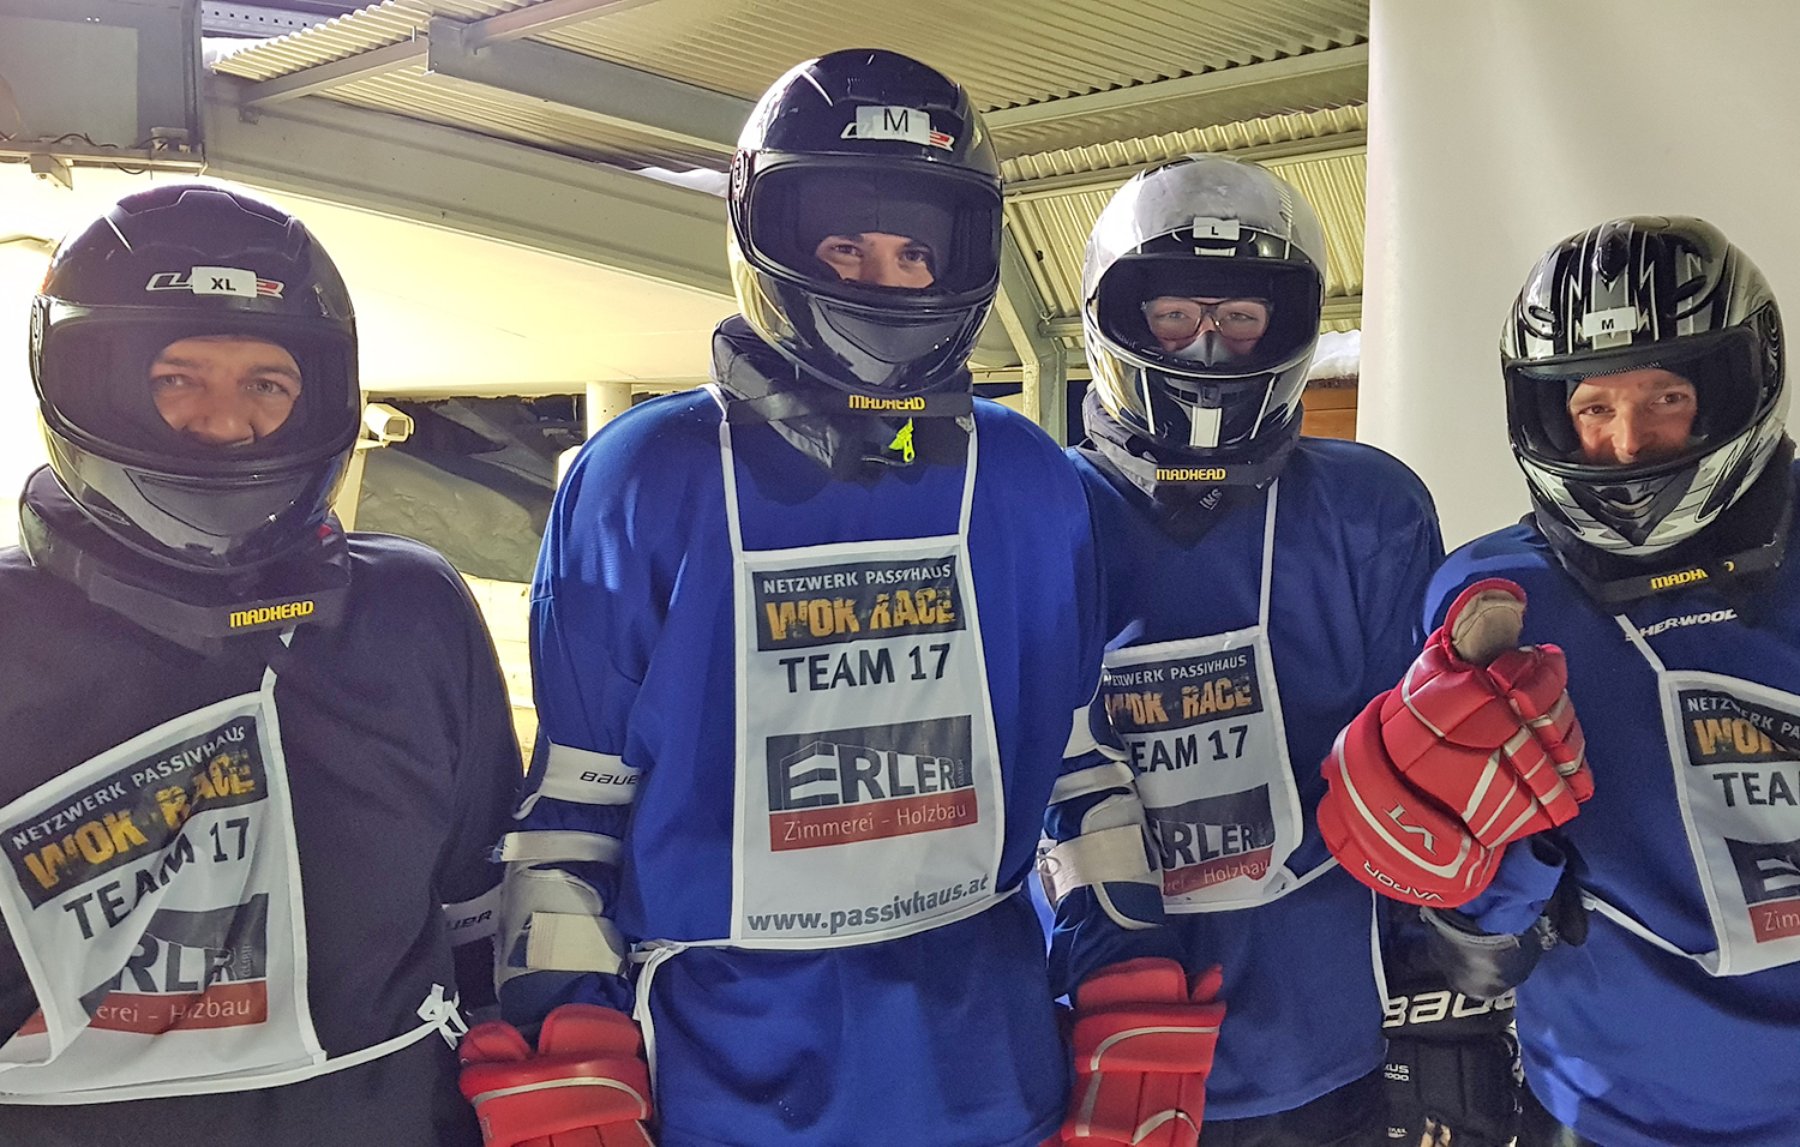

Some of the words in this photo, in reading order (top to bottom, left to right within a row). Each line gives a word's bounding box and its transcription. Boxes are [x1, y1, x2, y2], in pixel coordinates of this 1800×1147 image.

[884, 108, 908, 132] M
[1211, 226, 1219, 235] L
[211, 277, 236, 291] XL
[1602, 319, 1614, 330] M
[1156, 468, 1226, 480] MADHEAD
[763, 571, 858, 594] NETZWERK
[865, 563, 951, 585] PASSIVHAUS
[229, 600, 314, 628] MADHEAD
[765, 597, 860, 641] WOK
[869, 586, 956, 630] RACE
[778, 647, 895, 693] TEAM
[908, 642, 950, 681] 17
[1170, 654, 1248, 680] PASSIVHAUS
[1181, 672, 1253, 720] RACE
[1128, 733, 1198, 773] EAM
[1208, 724, 1249, 761] 17
[12, 781, 128, 850] NETZWERK
[132, 726, 246, 788] PASSIVHAUS
[780, 740, 956, 811] ERLER
[1712, 770, 1800, 808] TEA
[24, 809, 149, 890] WOK
[155, 748, 257, 831] RACE
[784, 811, 874, 841] Zimmerei
[896, 802, 967, 826] Holzbau
[1158, 820, 1255, 870] RLER
[63, 833, 195, 940] TEAM
[209, 816, 250, 863] 17
[1363, 860, 1444, 902] VAPOR
[747, 873, 989, 935] www.passivhaus.at
